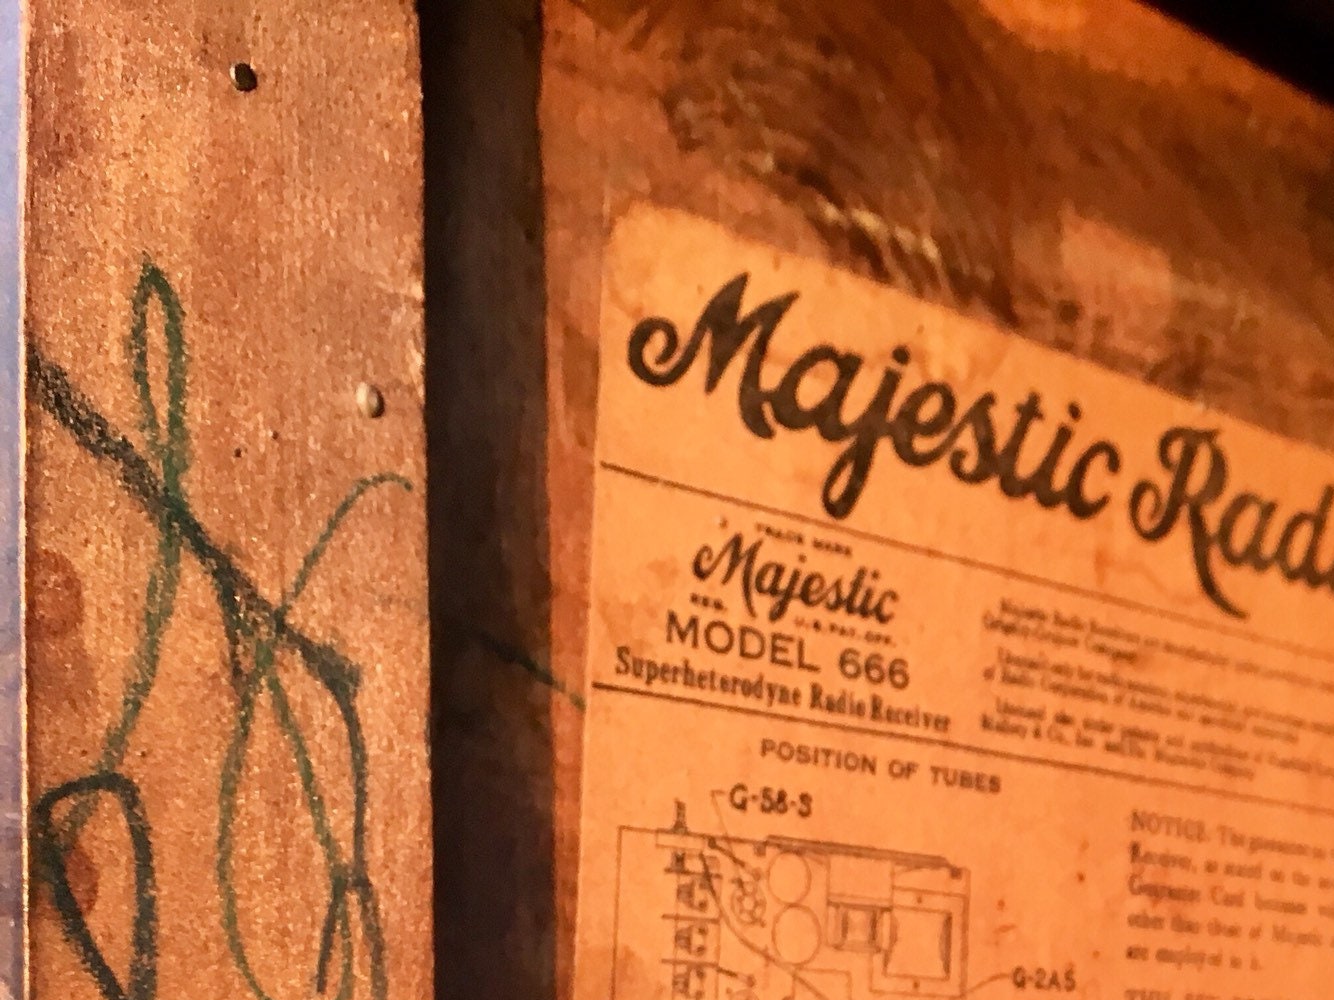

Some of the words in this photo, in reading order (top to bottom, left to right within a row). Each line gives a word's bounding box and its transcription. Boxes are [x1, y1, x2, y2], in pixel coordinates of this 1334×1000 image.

[627, 272, 1121, 519] Majestic
[691, 532, 899, 624] Majestic
[615, 645, 801, 707] Superheterodyne
[810, 682, 867, 717] Radio
[871, 694, 951, 733] Receiver
[666, 609, 820, 673] MODEL
[839, 647, 910, 690] 666
[760, 738, 877, 776] POSITION
[888, 759, 919, 780] OF
[930, 765, 1001, 794] TUBES
[1012, 964, 1076, 993] G-2A5
